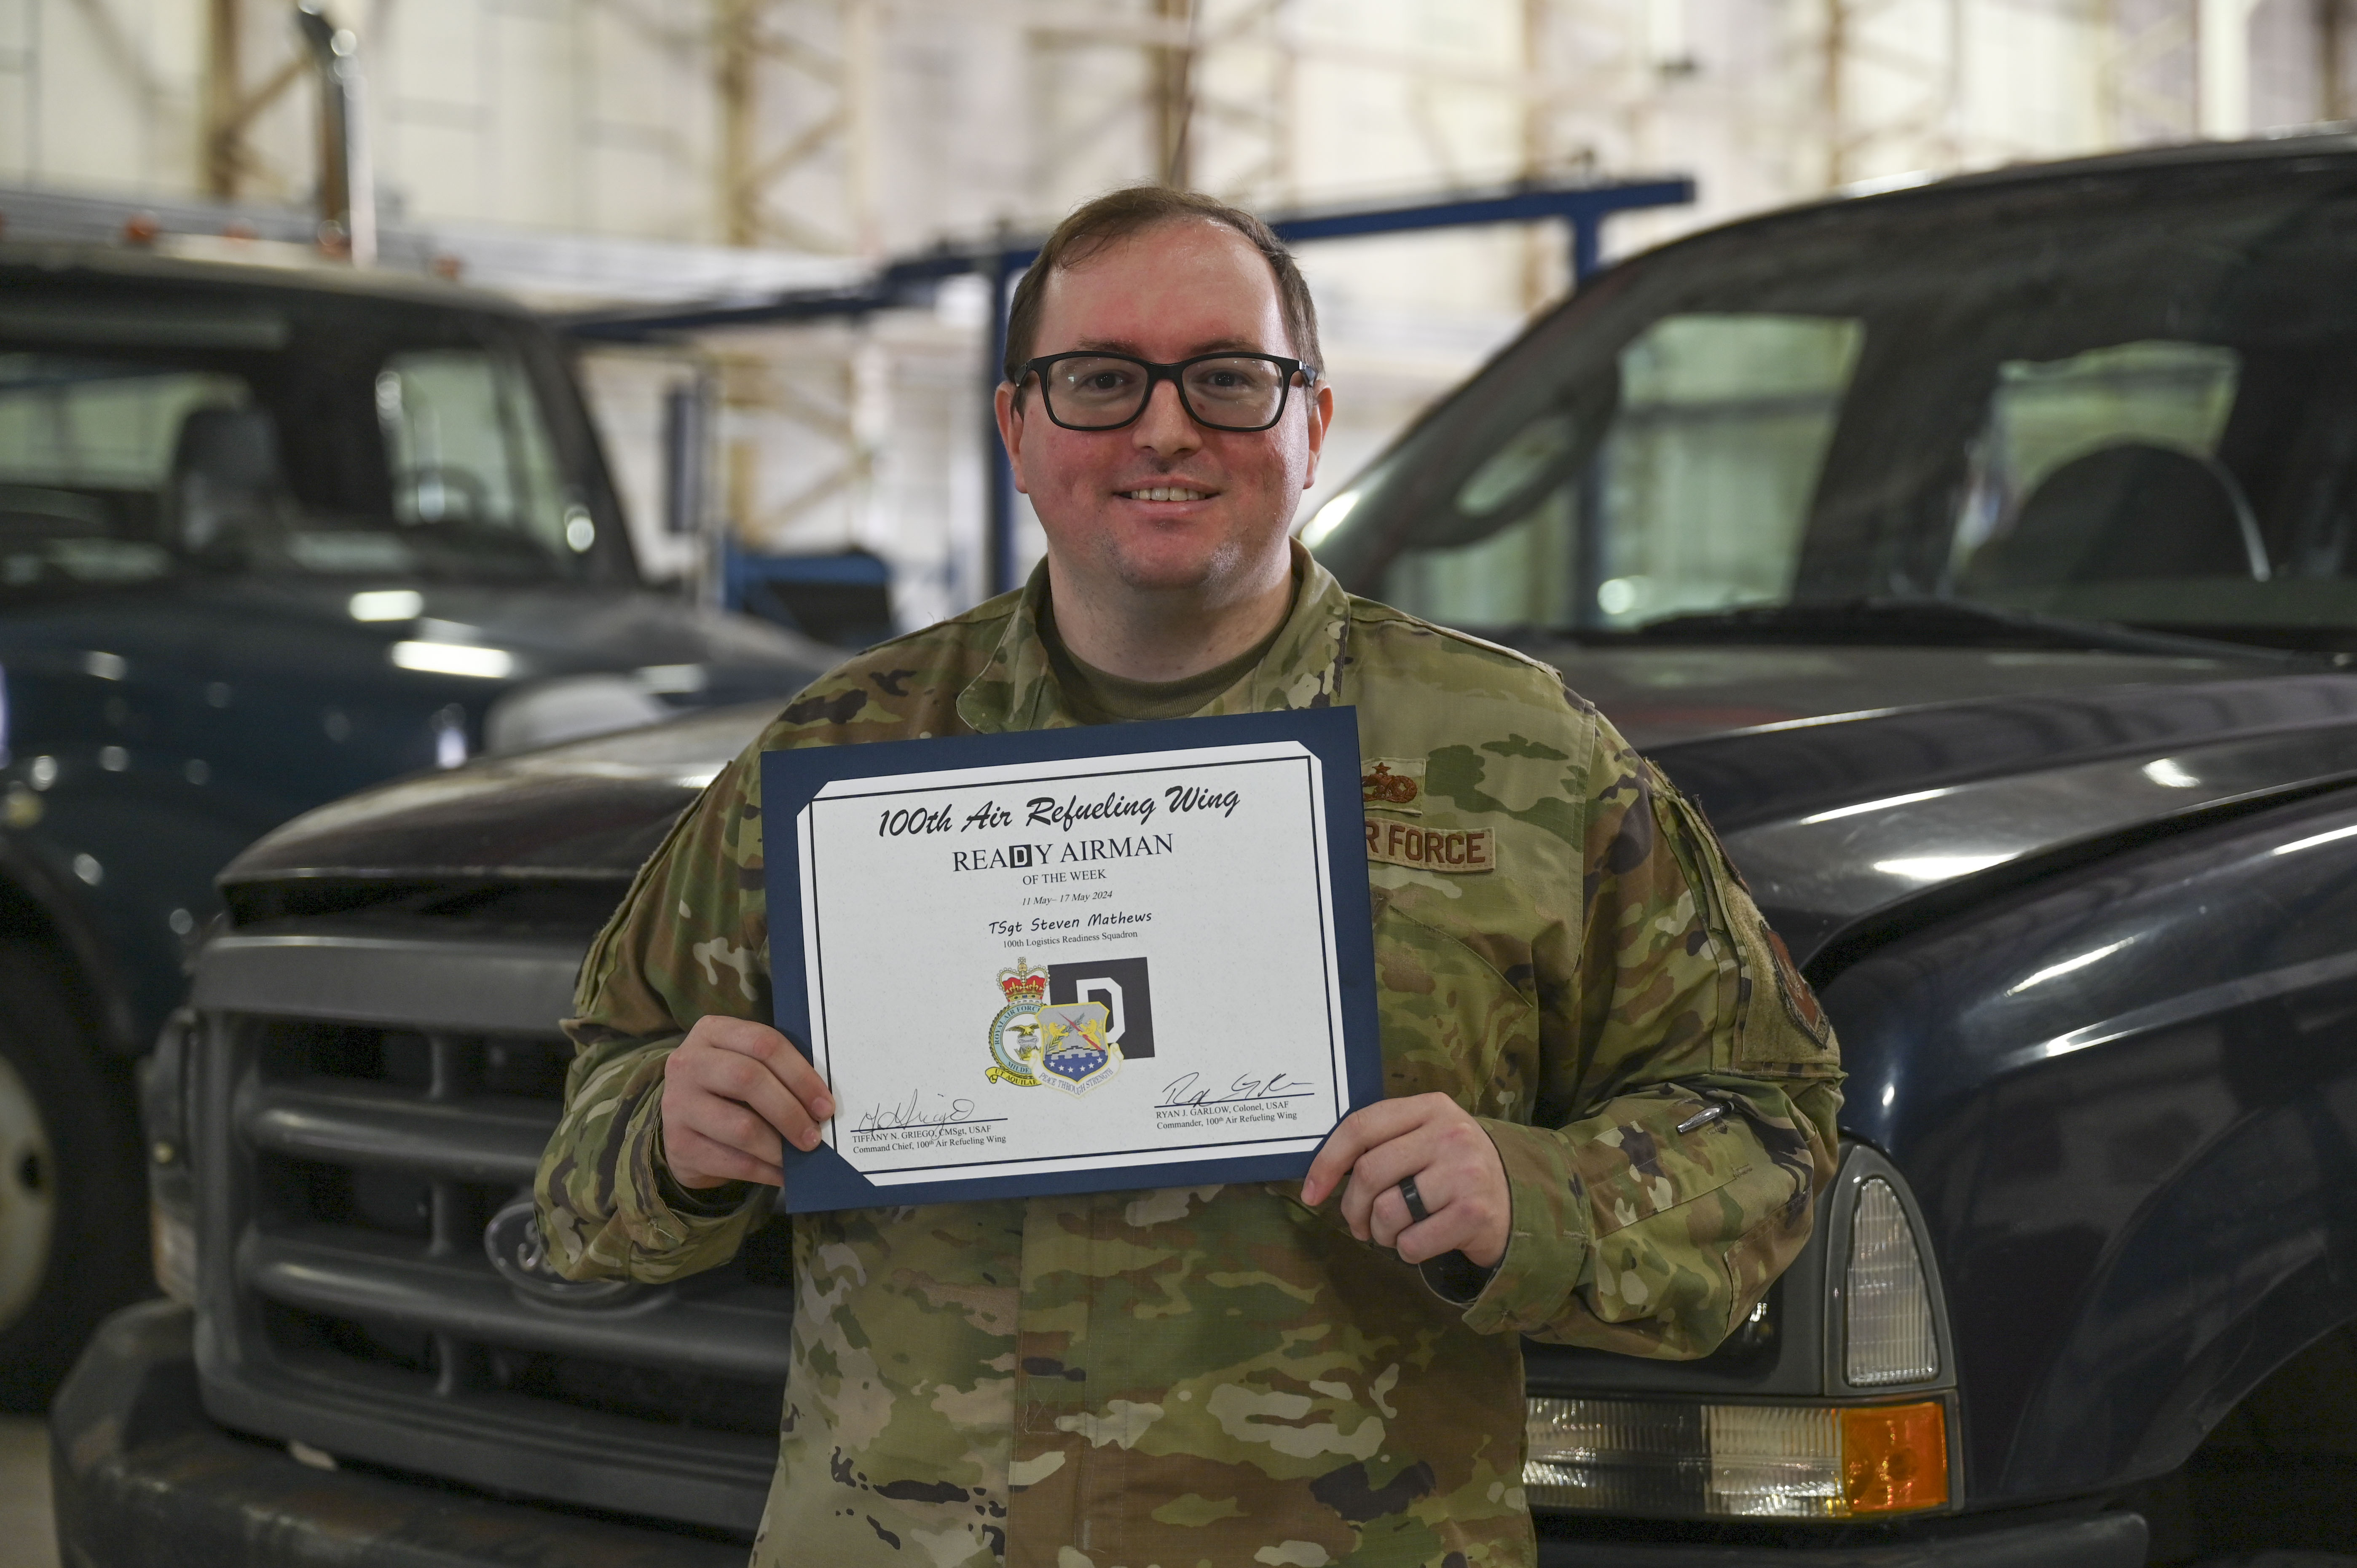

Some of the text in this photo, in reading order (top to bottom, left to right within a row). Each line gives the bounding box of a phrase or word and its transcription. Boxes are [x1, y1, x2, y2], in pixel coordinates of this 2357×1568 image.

[879, 785, 1241, 837] 100th Air Refueling Wing
[952, 833, 1173, 872] READY AIRMAN
[1389, 825, 1486, 864] FORCE
[1022, 869, 1107, 885] OF THE WEEK
[1059, 895, 1070, 903] 17
[1072, 893, 1090, 902] May
[1092, 890, 1113, 899] 2024
[989, 911, 1152, 937] TSgt Steven Mathews
[1003, 931, 1138, 948] 100th Logistics Readiness Squadron
[995, 1021, 1005, 1044] ROYAL
[1004, 1009, 1015, 1020] AIR
[1007, 1061, 1032, 1073] MILDE
[1006, 1075, 1038, 1085] AQUILAE
[1039, 1067, 1113, 1095] PEACE THROUGH STRENGTH
[1156, 1110, 1180, 1118] RYAN
[1190, 1106, 1231, 1116] GARLOW,
[1233, 1103, 1264, 1112] Colonel,
[1266, 1101, 1289, 1110] USAF
[1157, 1120, 1204, 1129] Commander,
[1225, 1116, 1237, 1124] Air
[1240, 1113, 1275, 1123] Refueling
[1277, 1111, 1298, 1120] Wing
[852, 1133, 888, 1143] TIFFANY
[901, 1129, 937, 1139] GRIEGO,
[939, 1127, 967, 1136] CMSgt,
[969, 1125, 991, 1134] USAF
[853, 1144, 890, 1153] Command
[892, 1142, 914, 1150] Chief,
[936, 1139, 947, 1147] Air
[949, 1137, 984, 1146] Refueling
[986, 1135, 1006, 1144] Wing
